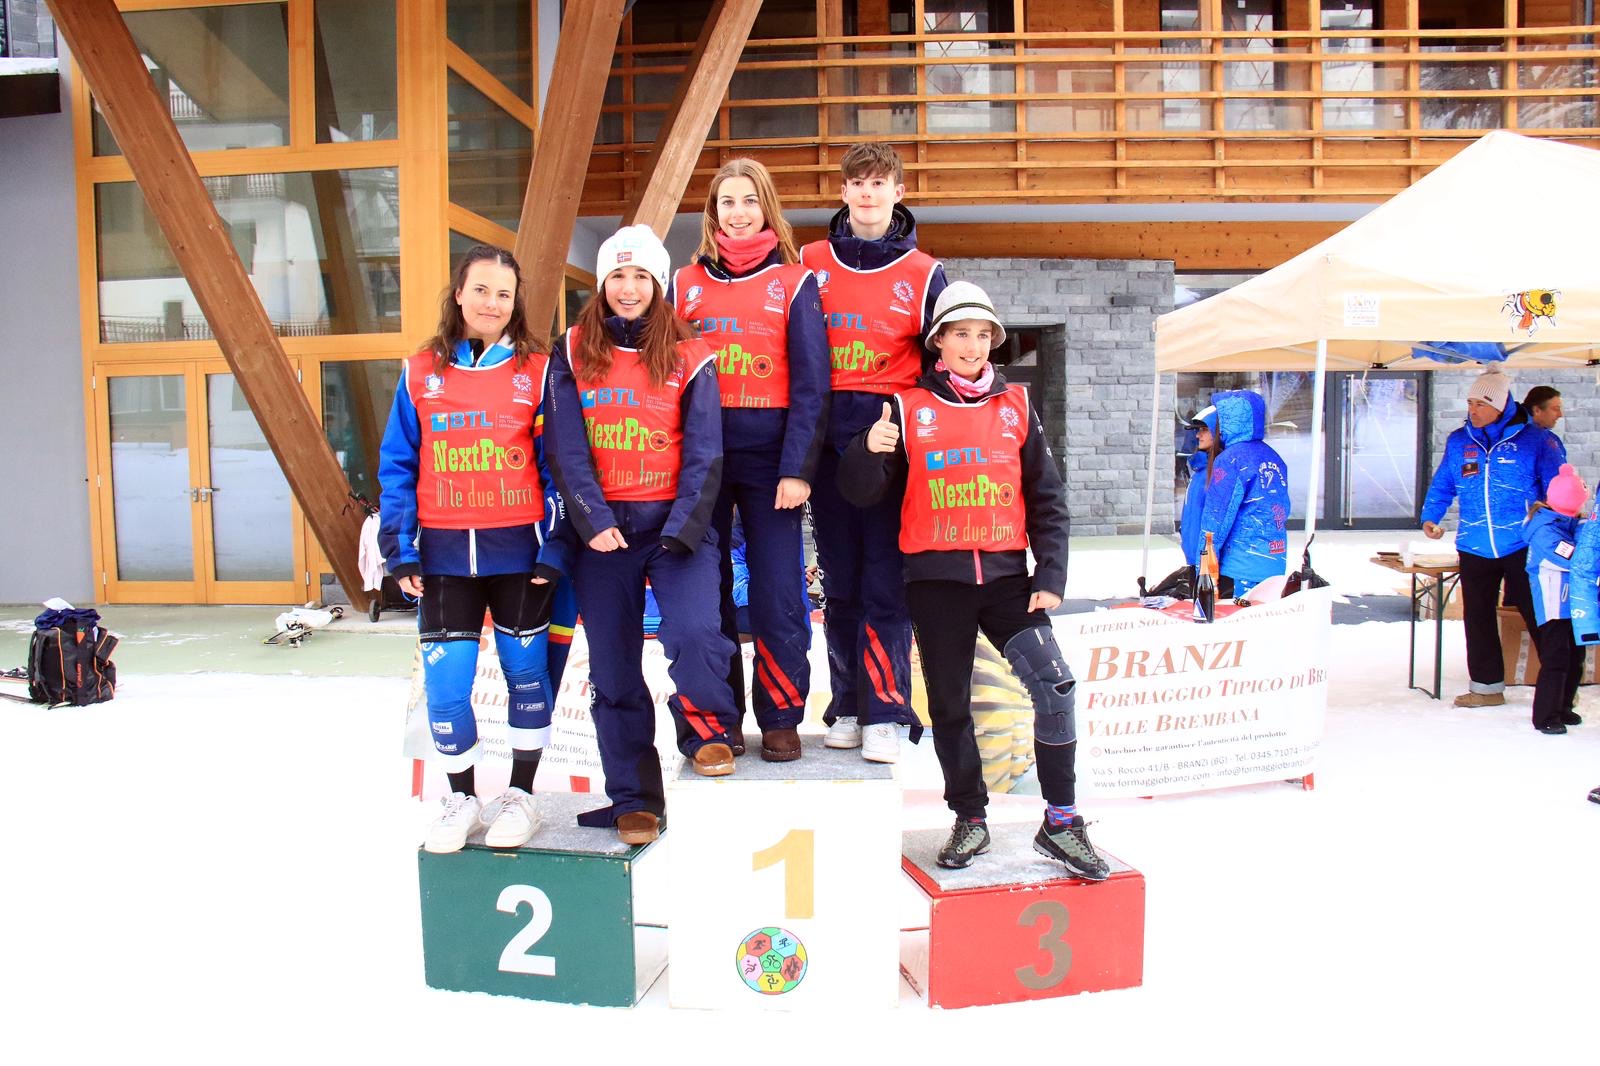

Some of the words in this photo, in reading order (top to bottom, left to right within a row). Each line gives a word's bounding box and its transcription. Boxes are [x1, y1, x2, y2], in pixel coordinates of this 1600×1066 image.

[704, 317, 744, 333] BTL
[830, 313, 868, 331] BTL
[716, 343, 773, 379] tPro
[597, 387, 640, 406] BTL
[450, 410, 494, 428] BTL
[433, 438, 526, 473] NextPro
[946, 447, 988, 465] BTL
[608, 456, 634, 487] due
[639, 458, 672, 487] torri
[448, 479, 463, 508] le
[468, 479, 495, 508] due
[500, 478, 533, 507] torri
[928, 474, 1014, 509] NextPro
[945, 514, 957, 542] le
[963, 513, 987, 542] due
[992, 513, 1014, 542] torri
[1083, 640, 1247, 682] BRANZI
[1087, 684, 1212, 710] FORMAGGIO
[1218, 677, 1284, 697] TIPICO
[1289, 674, 1304, 690] DI
[1088, 720, 1148, 737] VALLE
[1156, 708, 1259, 732] BREMBANA
[1118, 765, 1145, 775] Rocco
[1177, 758, 1209, 770] BRANZI
[752, 829, 815, 920] 1
[496, 884, 556, 977] 2
[1015, 901, 1072, 990] 3
